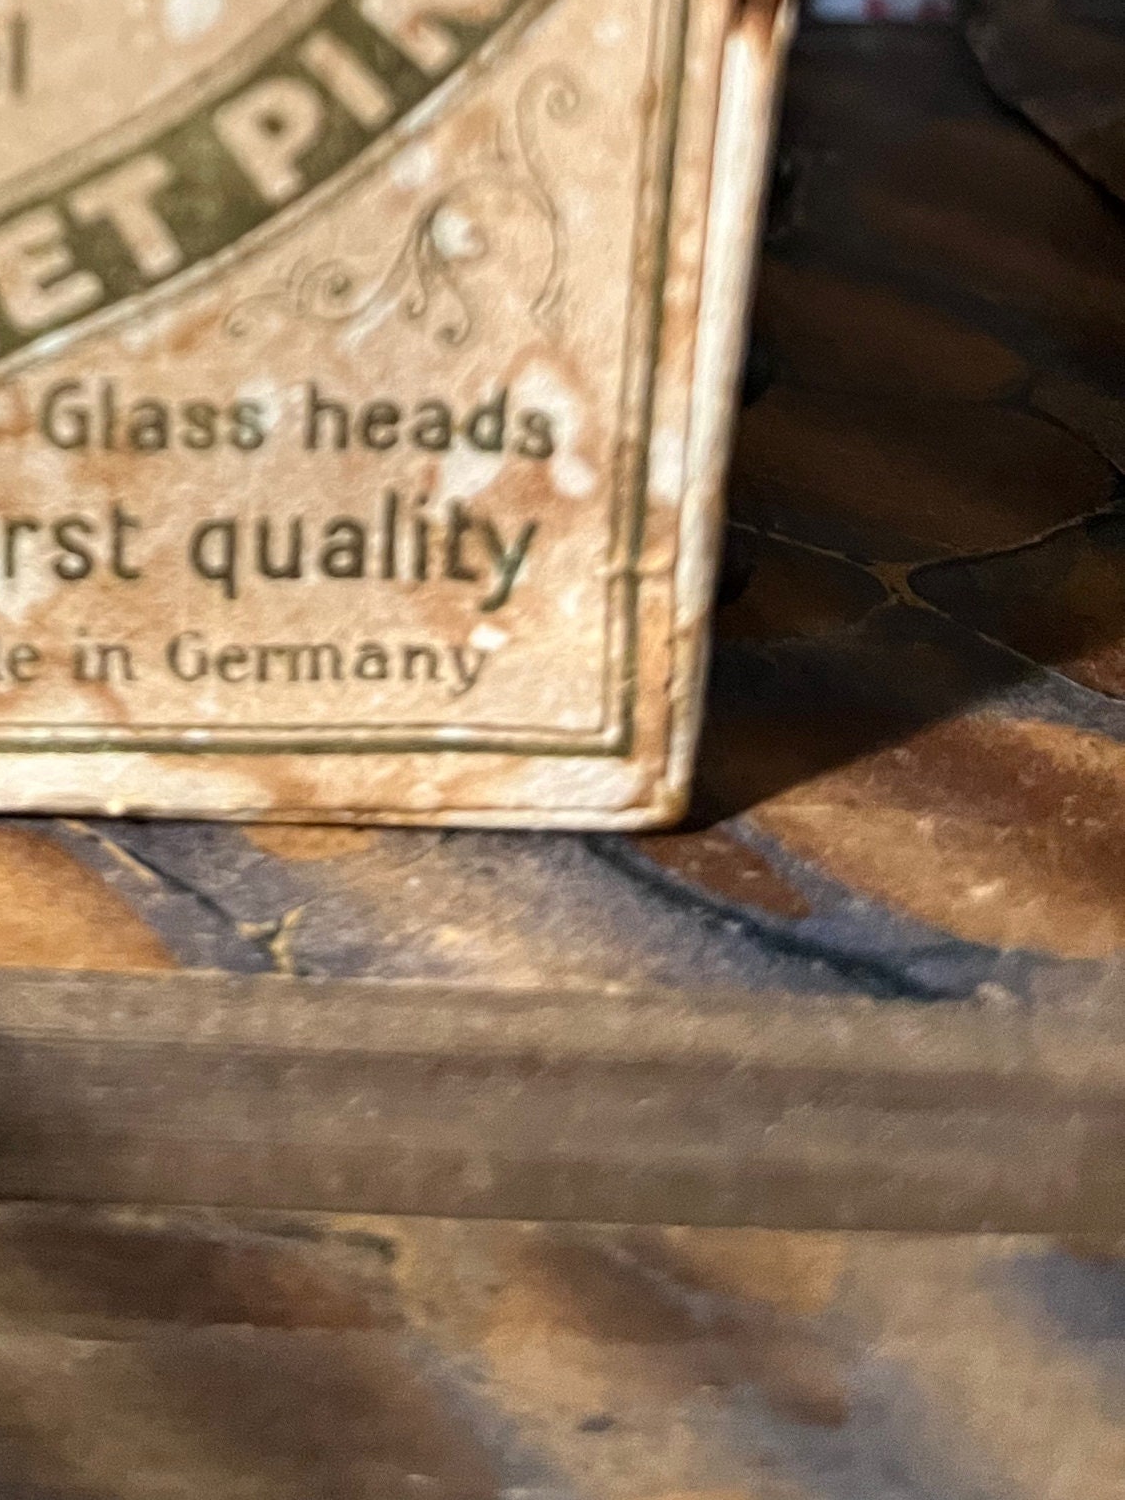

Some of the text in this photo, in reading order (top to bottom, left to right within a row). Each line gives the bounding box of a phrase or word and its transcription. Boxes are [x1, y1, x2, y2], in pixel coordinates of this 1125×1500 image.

[37, 378, 557, 460] Glass heads
[188, 492, 539, 612] quality
[72, 626, 139, 683] in
[164, 630, 490, 698] Germany
